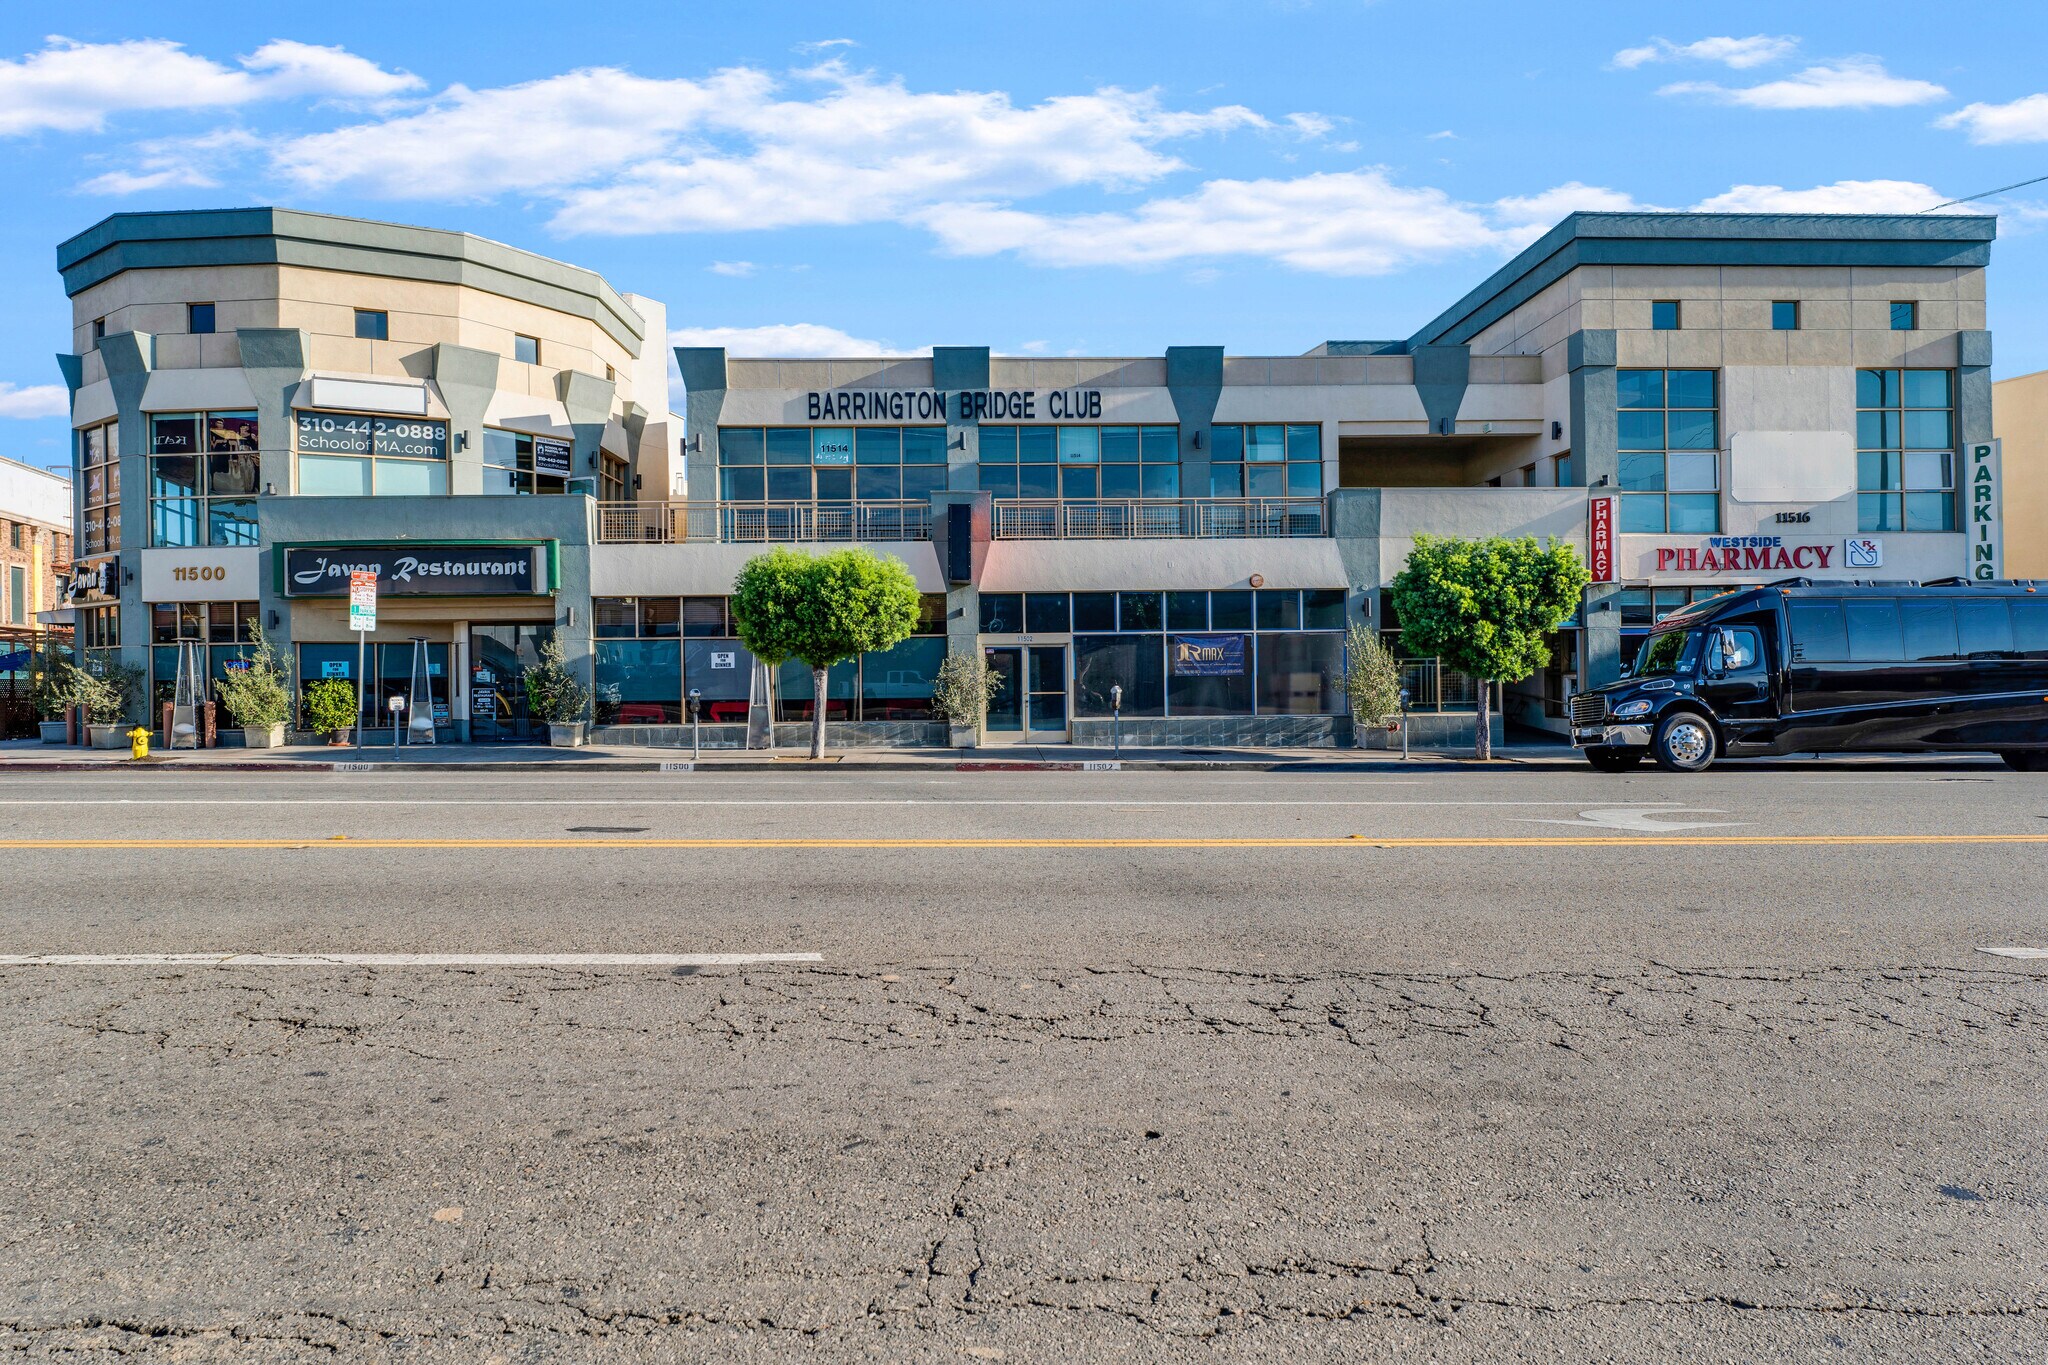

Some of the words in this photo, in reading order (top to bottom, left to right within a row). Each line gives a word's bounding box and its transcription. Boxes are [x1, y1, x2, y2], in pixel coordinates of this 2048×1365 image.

[808, 392, 947, 420] BARRINGTON
[960, 391, 1035, 419] BRIDGE
[1050, 391, 1102, 419] CLUB
[821, 444, 849, 452] 11514
[1775, 511, 1811, 524] 11516
[1974, 445, 1994, 580] PARKING
[1595, 500, 1607, 580] PHARMACY
[1709, 536, 1782, 548] WESTSIDE
[1656, 545, 1835, 571] PHARMACY
[172, 566, 226, 581] 11500
[294, 557, 382, 585] Javan
[391, 556, 527, 583] Restaurant
[343, 763, 369, 771] 11500
